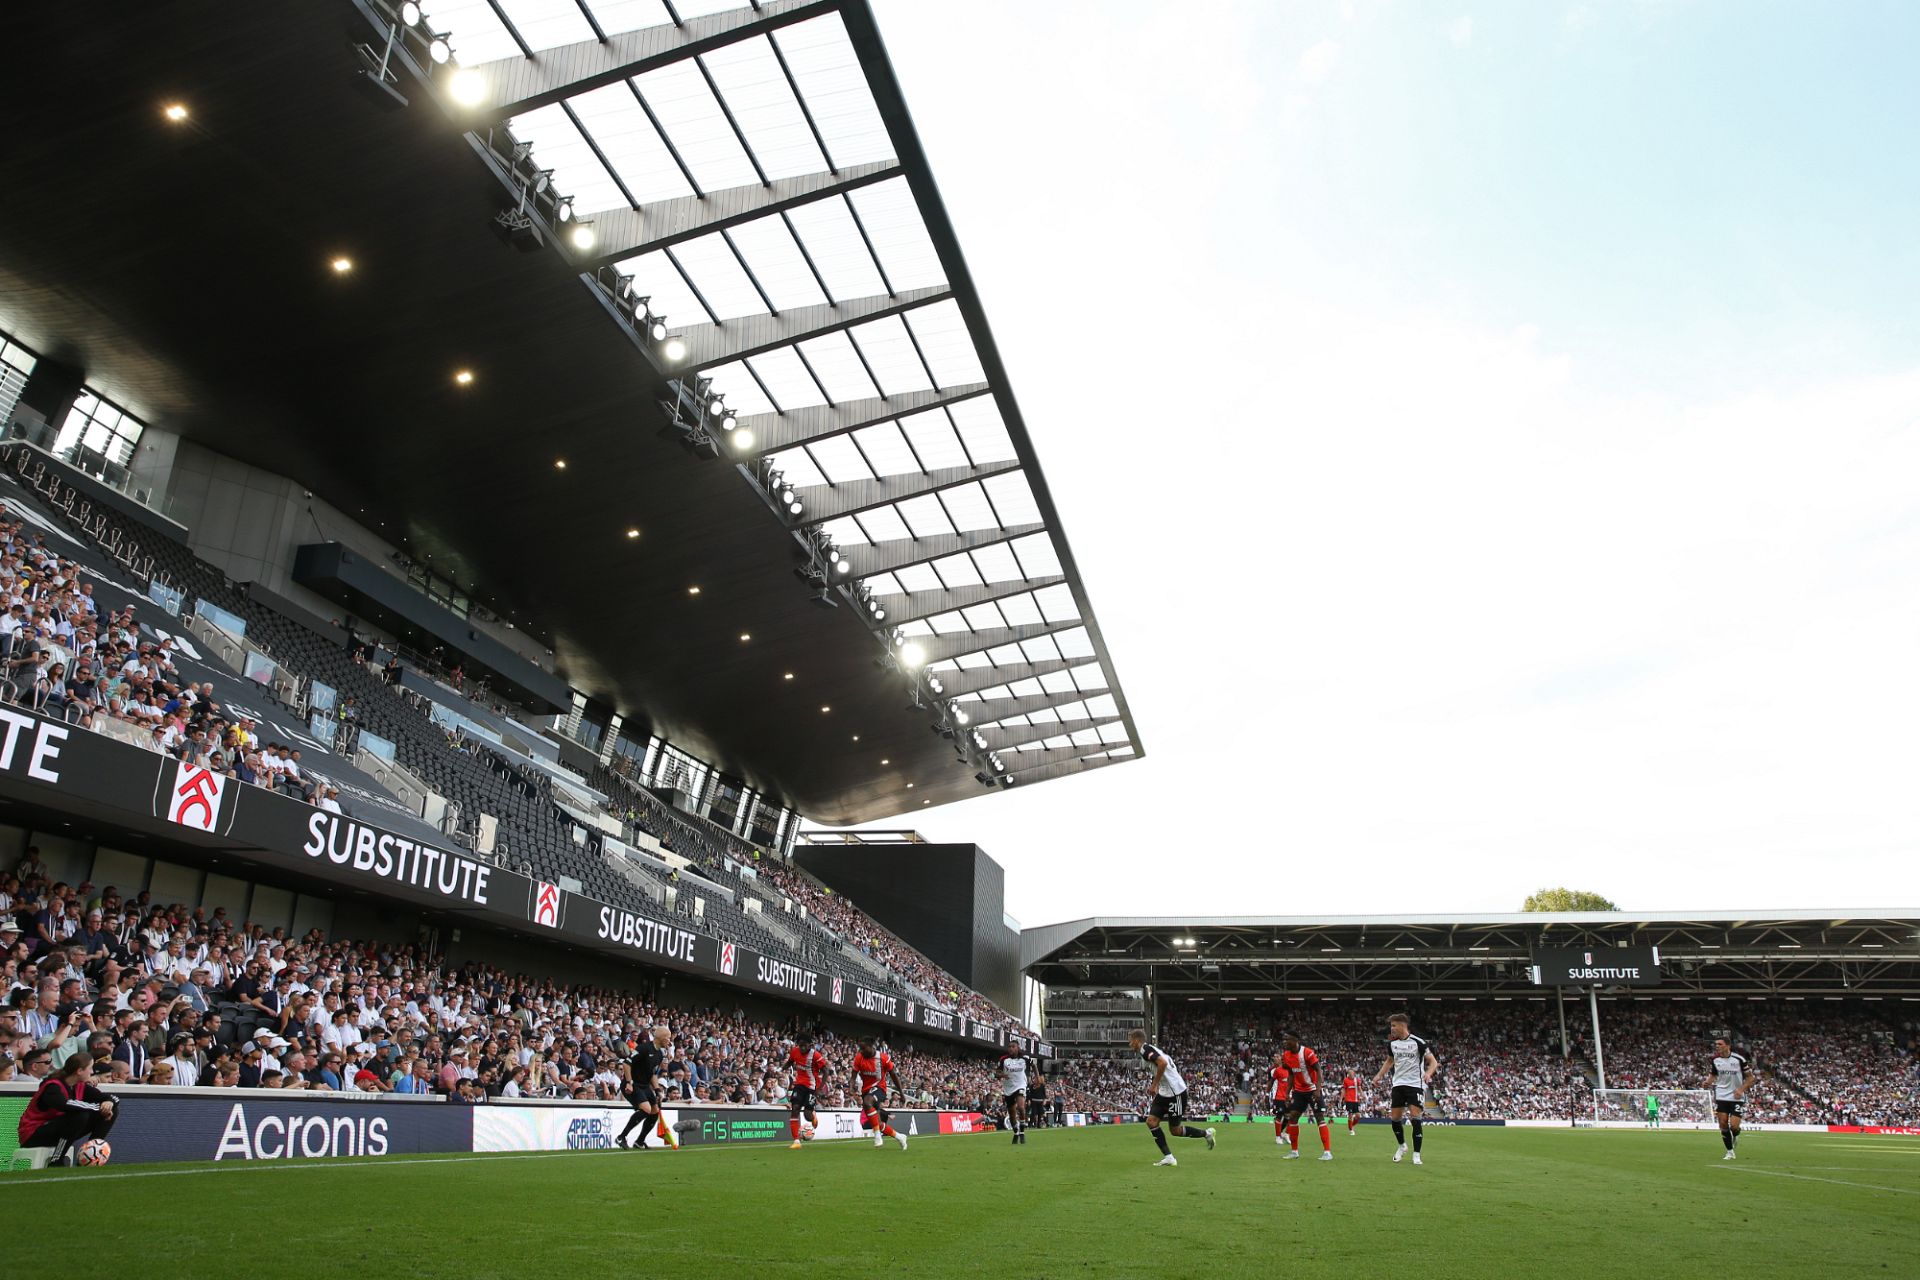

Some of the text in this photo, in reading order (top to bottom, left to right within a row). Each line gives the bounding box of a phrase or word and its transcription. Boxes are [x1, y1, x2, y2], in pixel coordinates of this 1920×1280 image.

[304, 812, 491, 905] SUBSTITUTE
[598, 906, 696, 962] SUBSTITUTE
[757, 956, 817, 996] SUBSTITUTE
[1569, 968, 1640, 978] SUBSTITUTE
[856, 987, 897, 1017] SUBSTITUTE
[923, 1008, 953, 1032] SUBSTITUTE
[1168, 1102, 1177, 1112] 21
[214, 1103, 388, 1161] Acronis
[568, 1118, 602, 1134] APPLIED
[703, 1121, 727, 1140] FIS
[567, 1133, 612, 1149] NUTRITION
